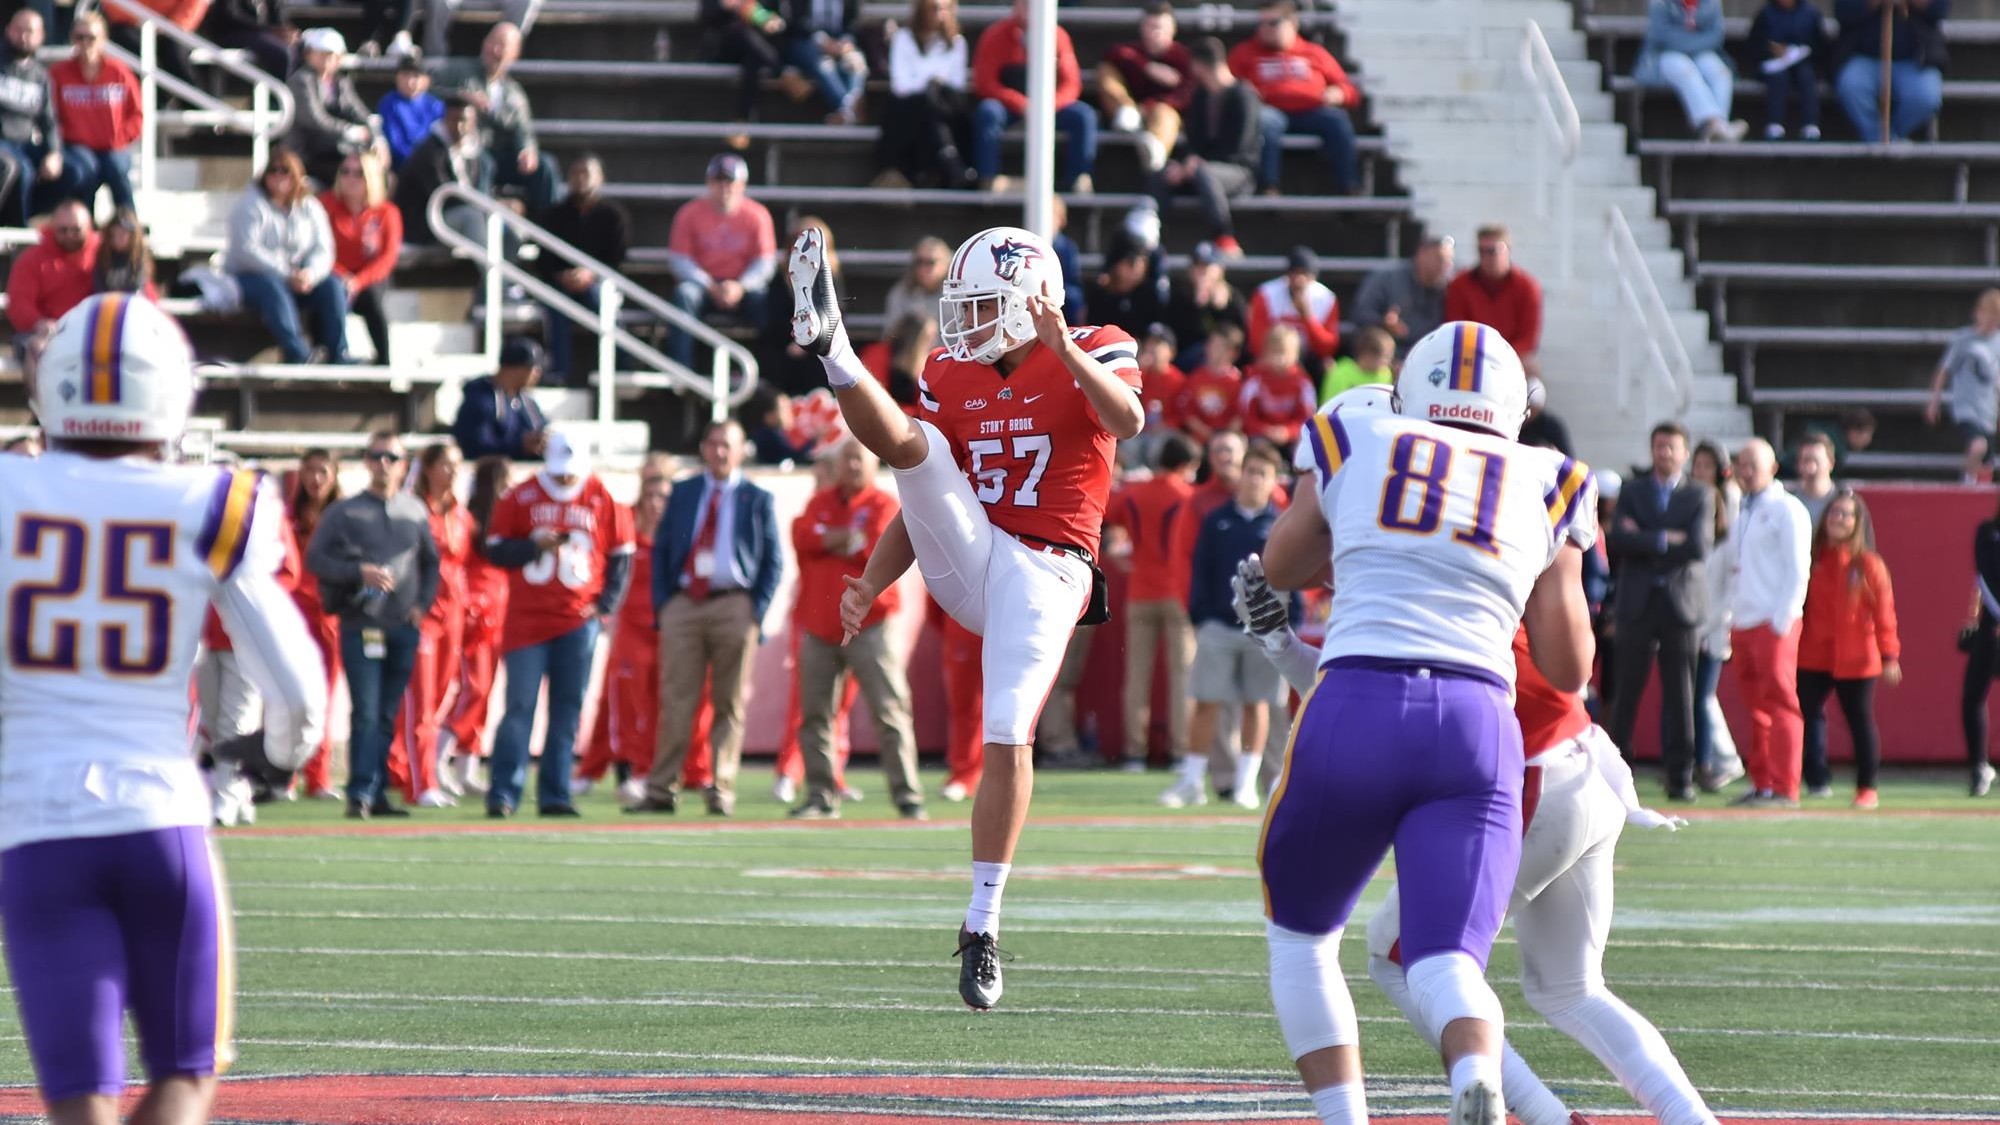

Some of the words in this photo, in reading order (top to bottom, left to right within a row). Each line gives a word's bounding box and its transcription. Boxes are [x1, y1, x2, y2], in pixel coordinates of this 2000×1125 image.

[964, 398, 984, 408] CAA
[980, 420, 1005, 434] STONY
[1009, 417, 1034, 431] BROOK
[1428, 403, 1494, 423] Riddell
[967, 432, 1053, 507] 57
[1377, 432, 1508, 560] 81
[7, 512, 177, 677] 25
